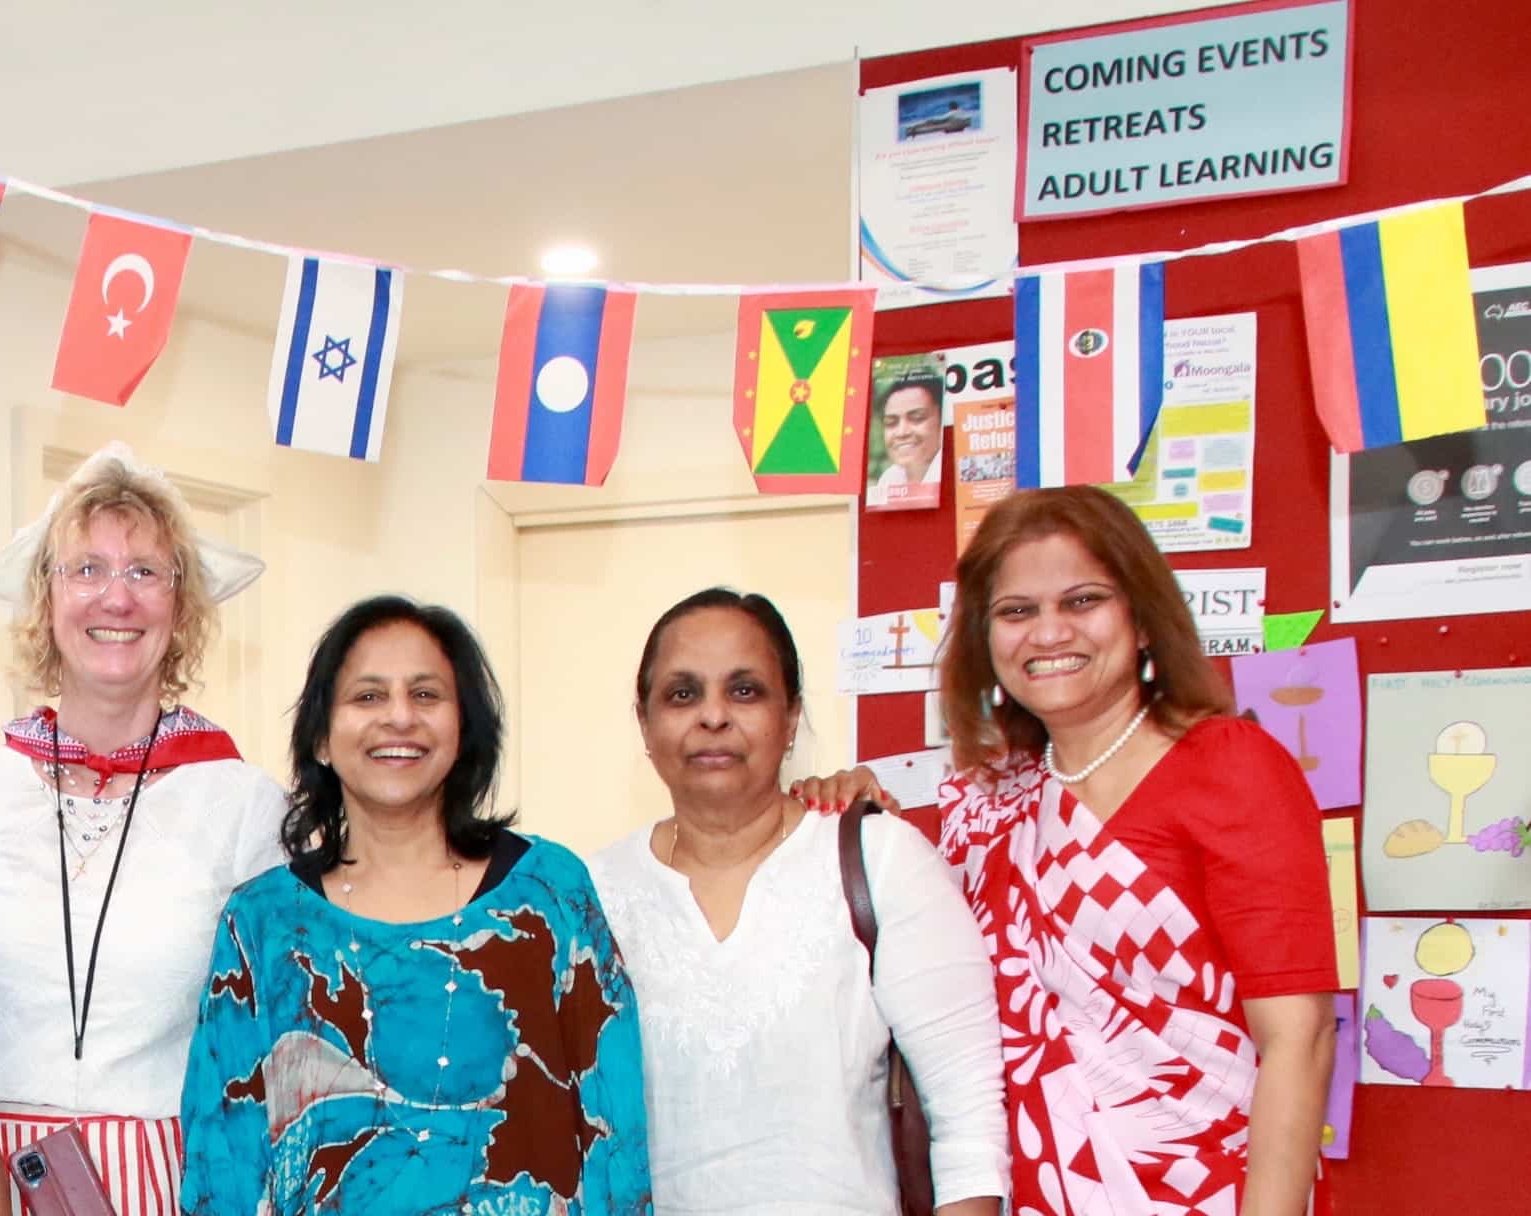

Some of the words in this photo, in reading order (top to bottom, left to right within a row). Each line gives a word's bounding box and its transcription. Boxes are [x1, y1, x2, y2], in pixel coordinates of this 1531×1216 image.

[1043, 50, 1186, 94] COMING
[1197, 28, 1329, 74] EVENTS
[1042, 103, 1207, 148] RETREATS
[1038, 165, 1150, 201] ADULT
[1158, 142, 1335, 189] LEARNING
[1191, 361, 1251, 377] Moongala
[961, 410, 1016, 433] Justic
[969, 432, 1016, 453] Refug
[1204, 638, 1251, 654] RAM
